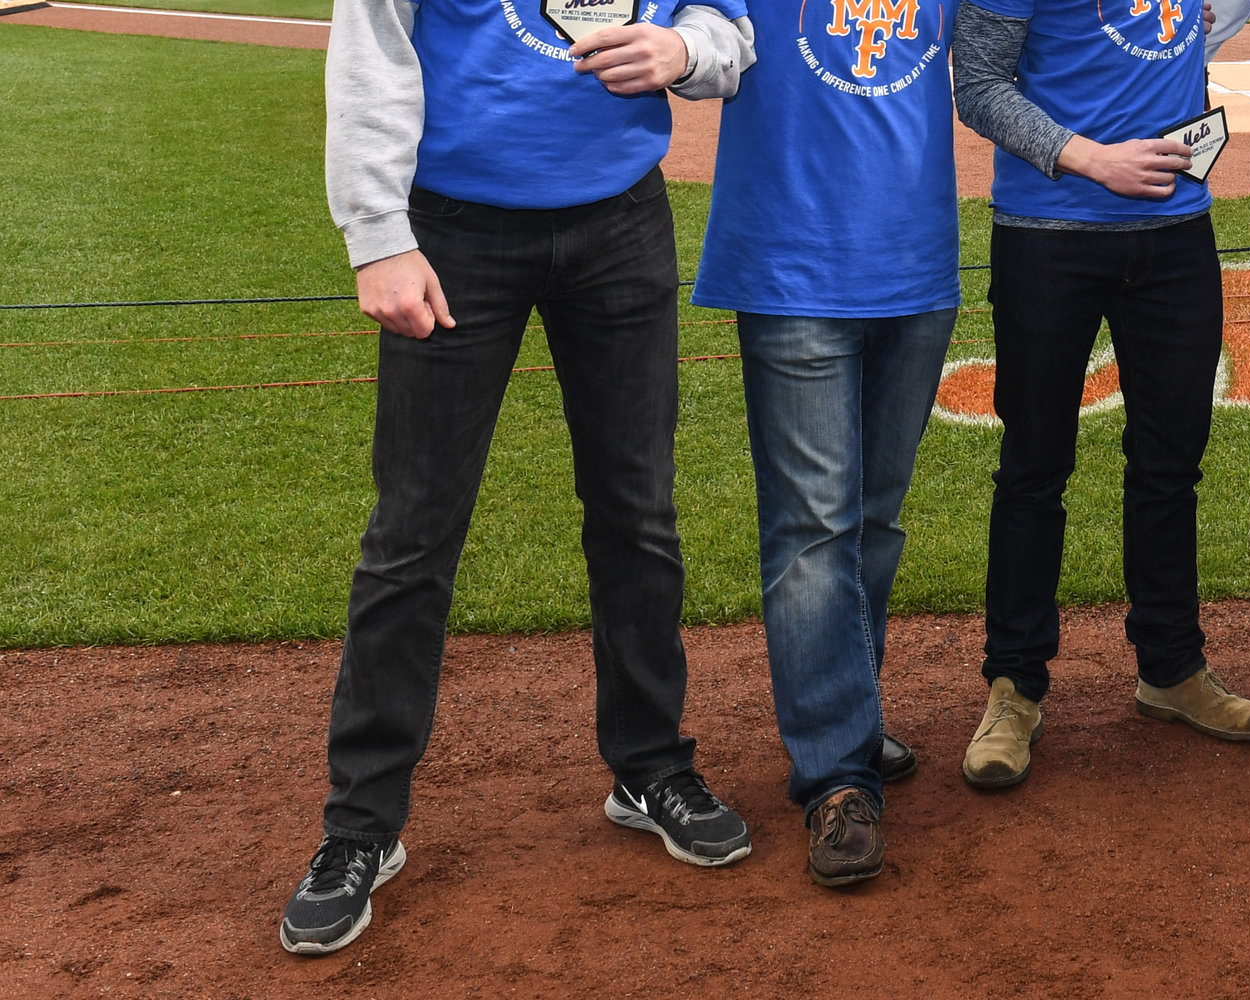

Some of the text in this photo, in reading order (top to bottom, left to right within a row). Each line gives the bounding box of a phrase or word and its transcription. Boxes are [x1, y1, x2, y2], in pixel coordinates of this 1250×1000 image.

[641, 1, 658, 24] TIME
[796, 37, 941, 97] MAKING DIFFERENCE ONE CHILD TIME
